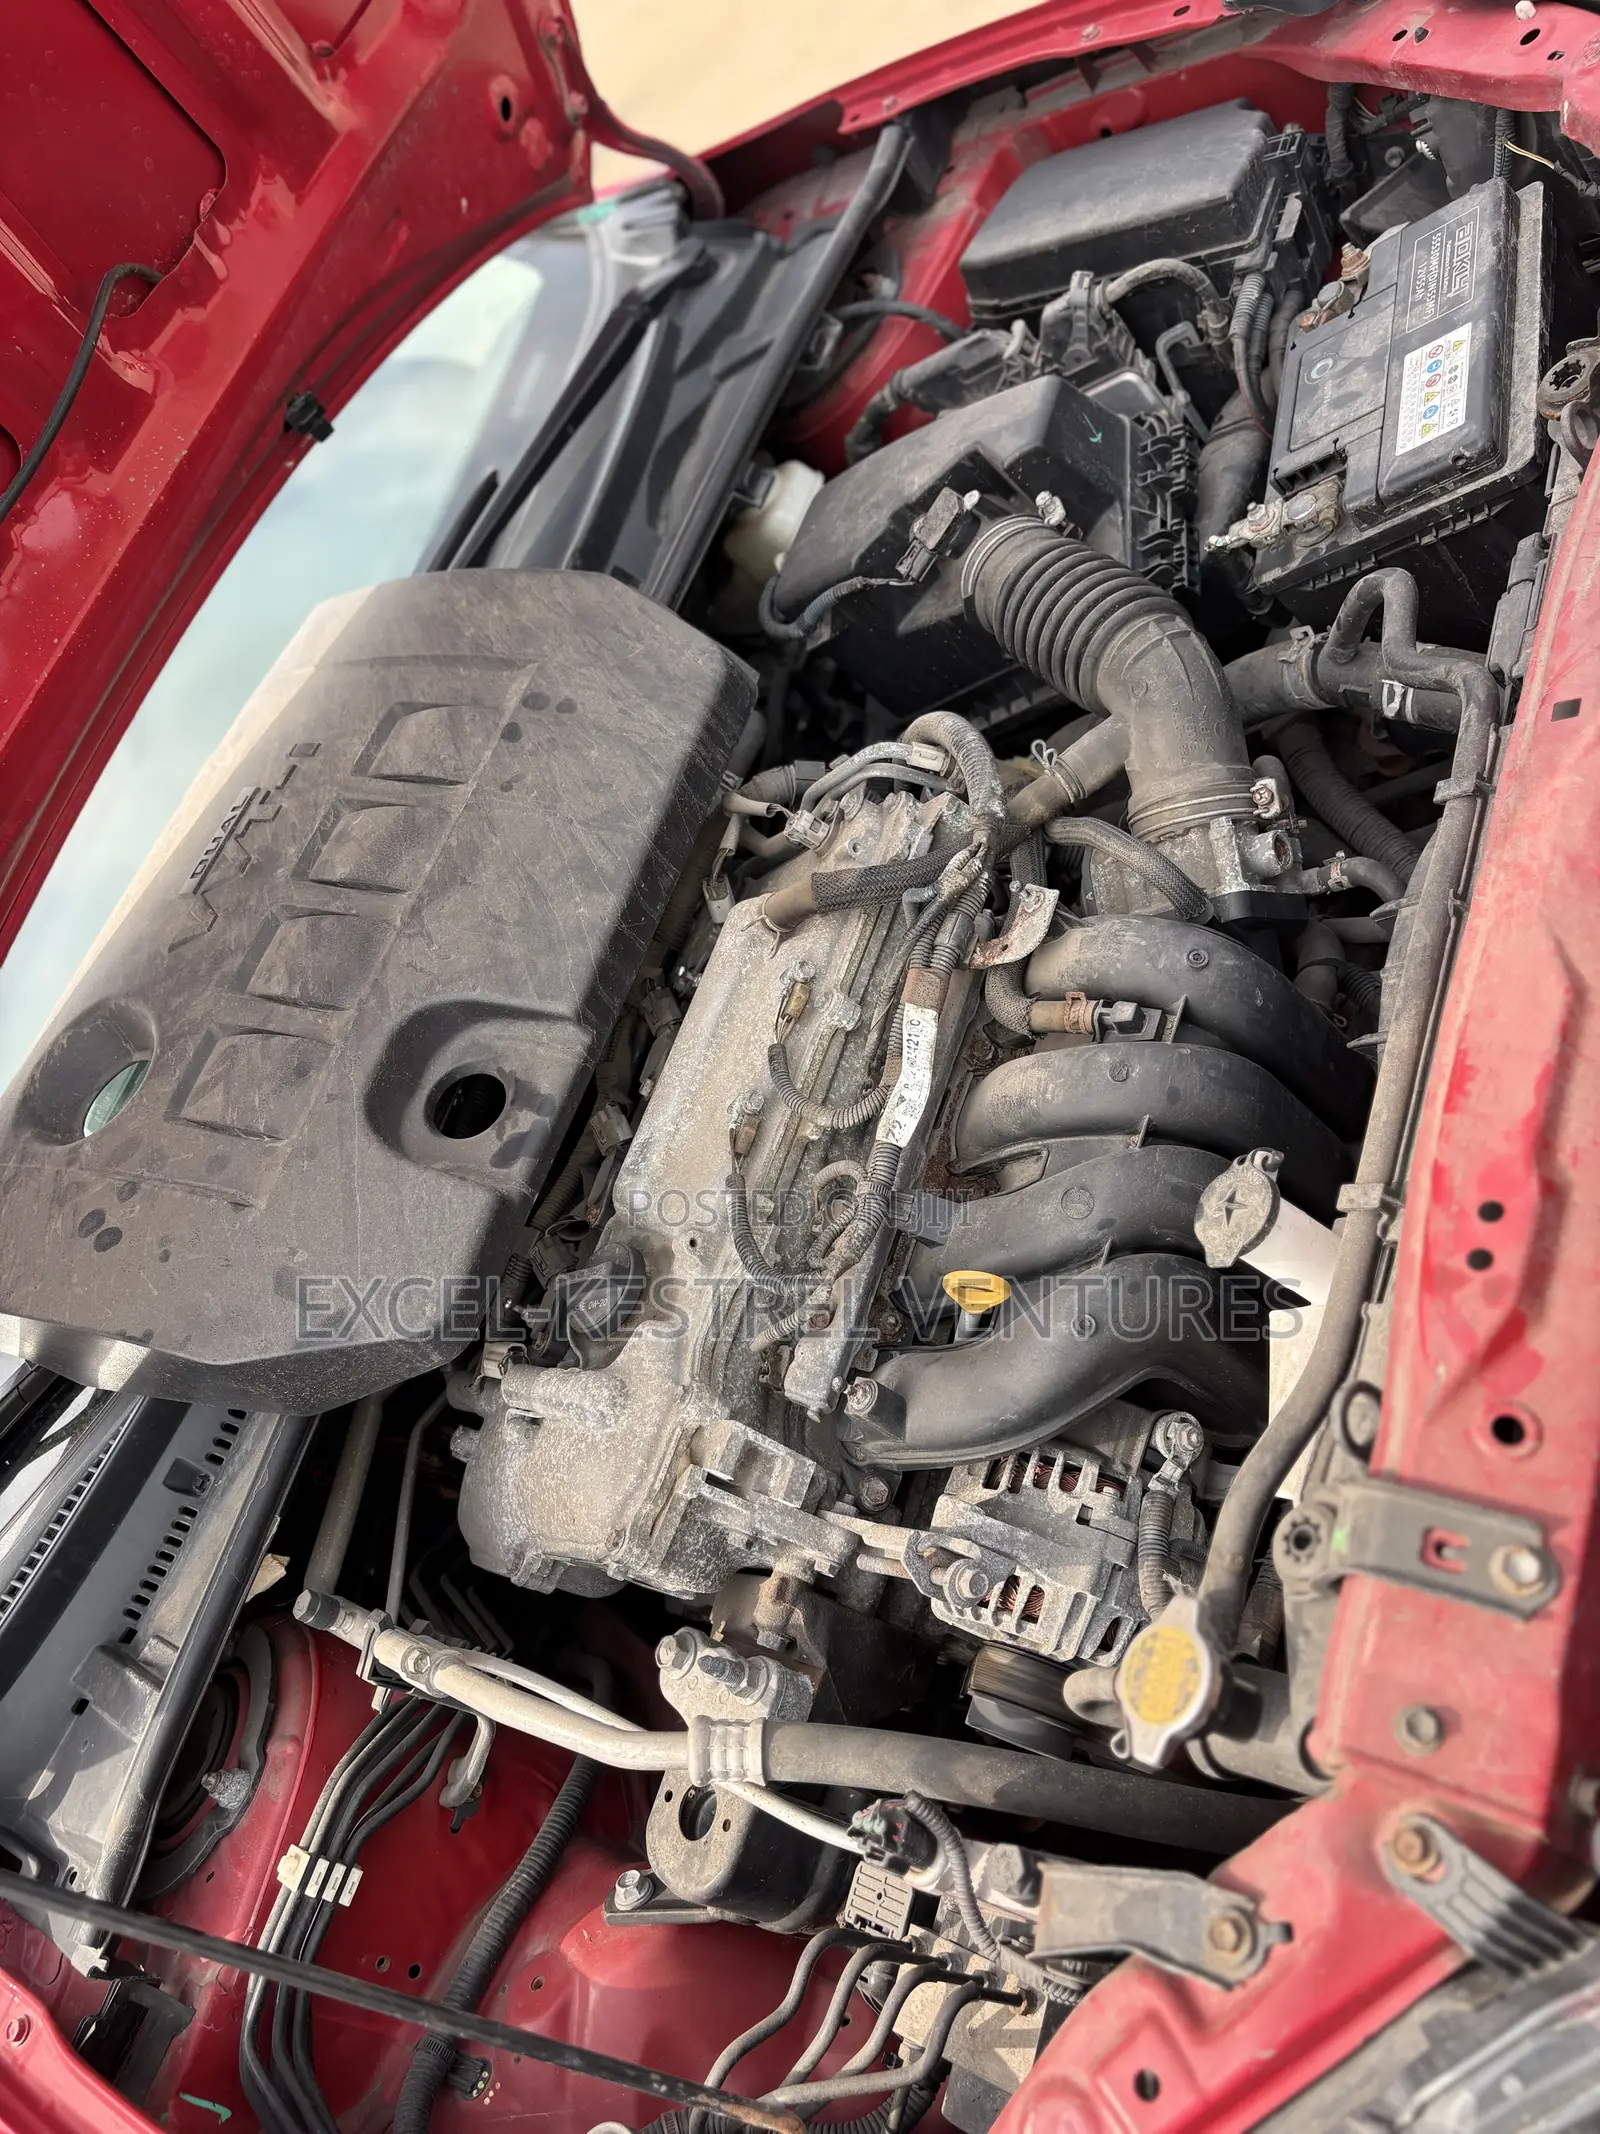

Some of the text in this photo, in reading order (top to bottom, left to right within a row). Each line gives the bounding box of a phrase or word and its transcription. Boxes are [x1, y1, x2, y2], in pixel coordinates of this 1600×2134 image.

[1414, 261, 1427, 301] 12V55Ah
[190, 795, 249, 880] DUAL
[588, 1298, 608, 1310] 0W-20
